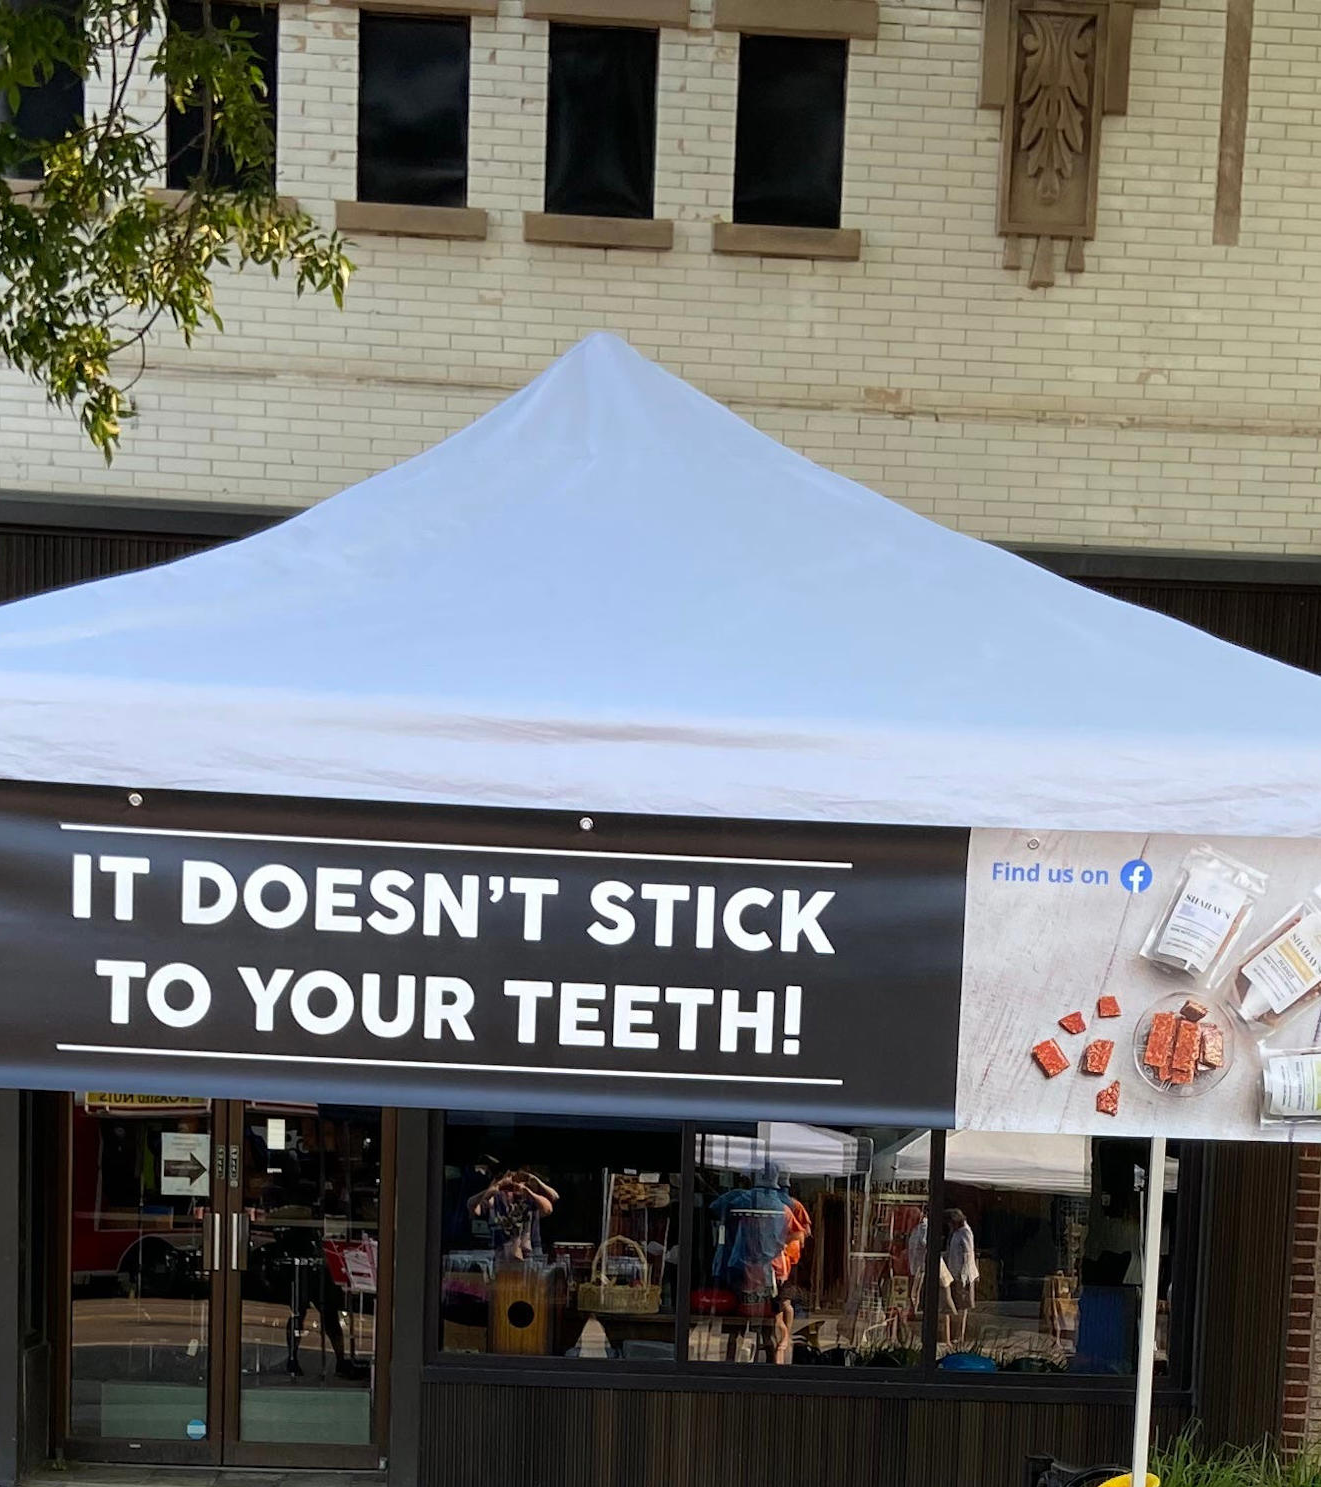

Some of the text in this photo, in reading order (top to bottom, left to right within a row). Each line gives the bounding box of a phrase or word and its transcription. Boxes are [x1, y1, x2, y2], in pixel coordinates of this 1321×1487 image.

[72, 852, 836, 955] IT DOESN'T STICK
[992, 861, 1040, 883] Find
[1048, 868, 1073, 884] us
[1081, 869, 1109, 885] on
[95, 958, 803, 1055] TO YOUR TEETH!
